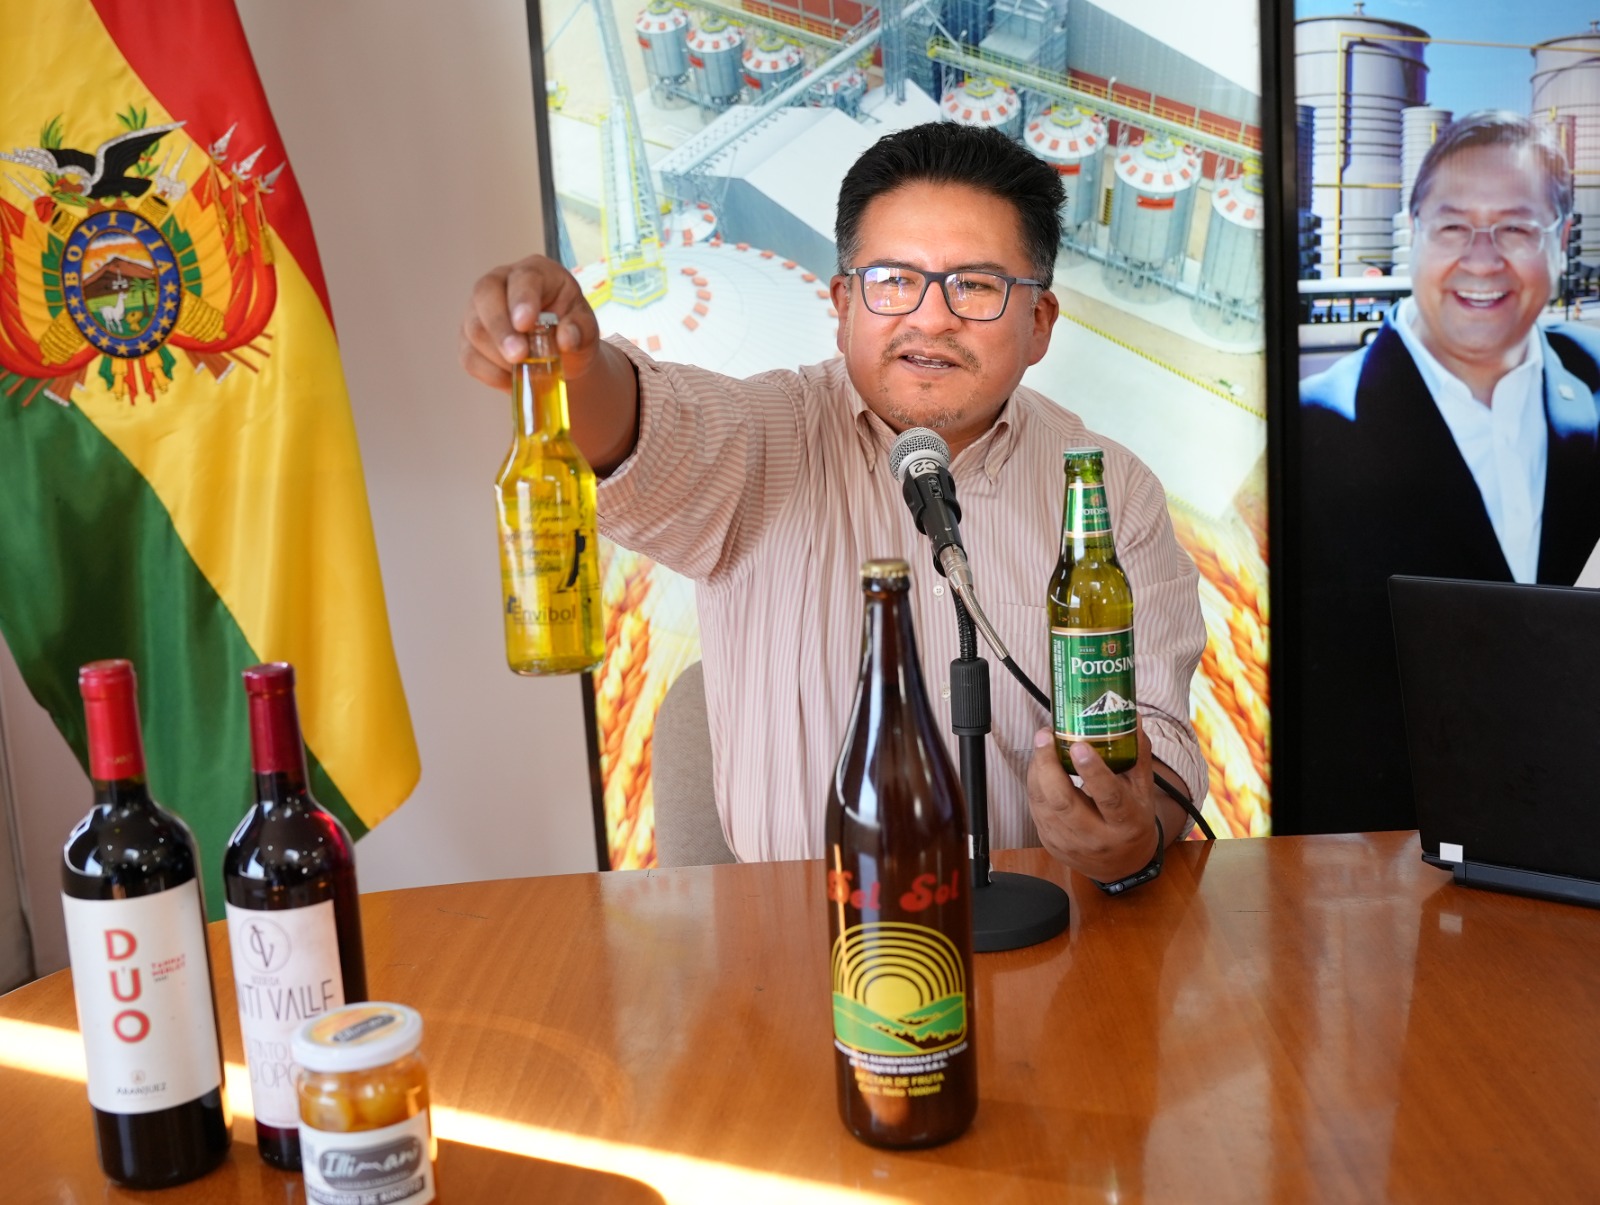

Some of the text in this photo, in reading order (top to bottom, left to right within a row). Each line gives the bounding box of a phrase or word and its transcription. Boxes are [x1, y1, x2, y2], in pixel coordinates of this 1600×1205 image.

[64, 212, 174, 288] BOLIVIA
[513, 603, 577, 622] Envibol
[1071, 654, 1135, 676] POTOSIN
[899, 870, 959, 912] Sol
[104, 928, 151, 1044] DUO
[894, 1076, 910, 1087] DE
[911, 1072, 945, 1086] FRUTA
